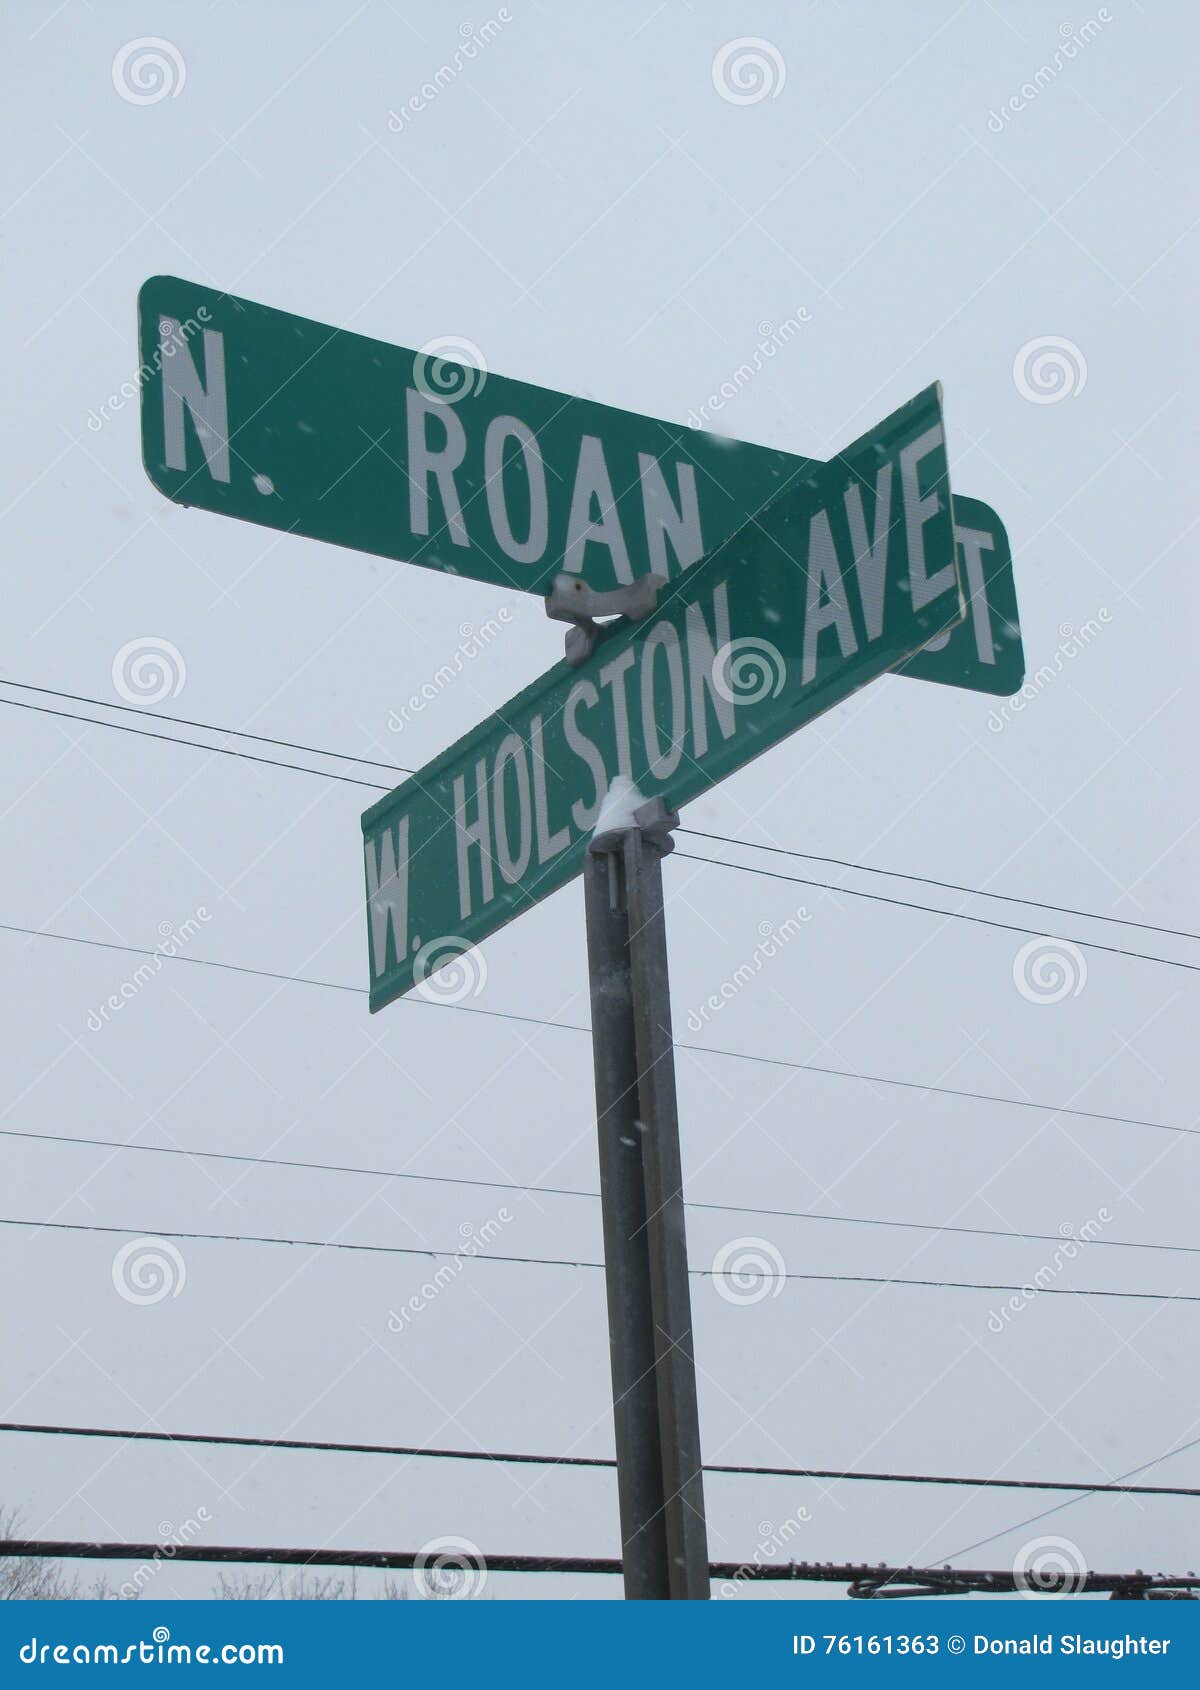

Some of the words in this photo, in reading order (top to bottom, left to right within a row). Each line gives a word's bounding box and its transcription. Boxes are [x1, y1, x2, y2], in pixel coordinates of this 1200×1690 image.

[364, 814, 422, 978] W.
[452, 578, 737, 921] HOLSTON
[800, 421, 957, 687] AVE
[406, 386, 705, 586] ROAN
[922, 523, 997, 666] T
